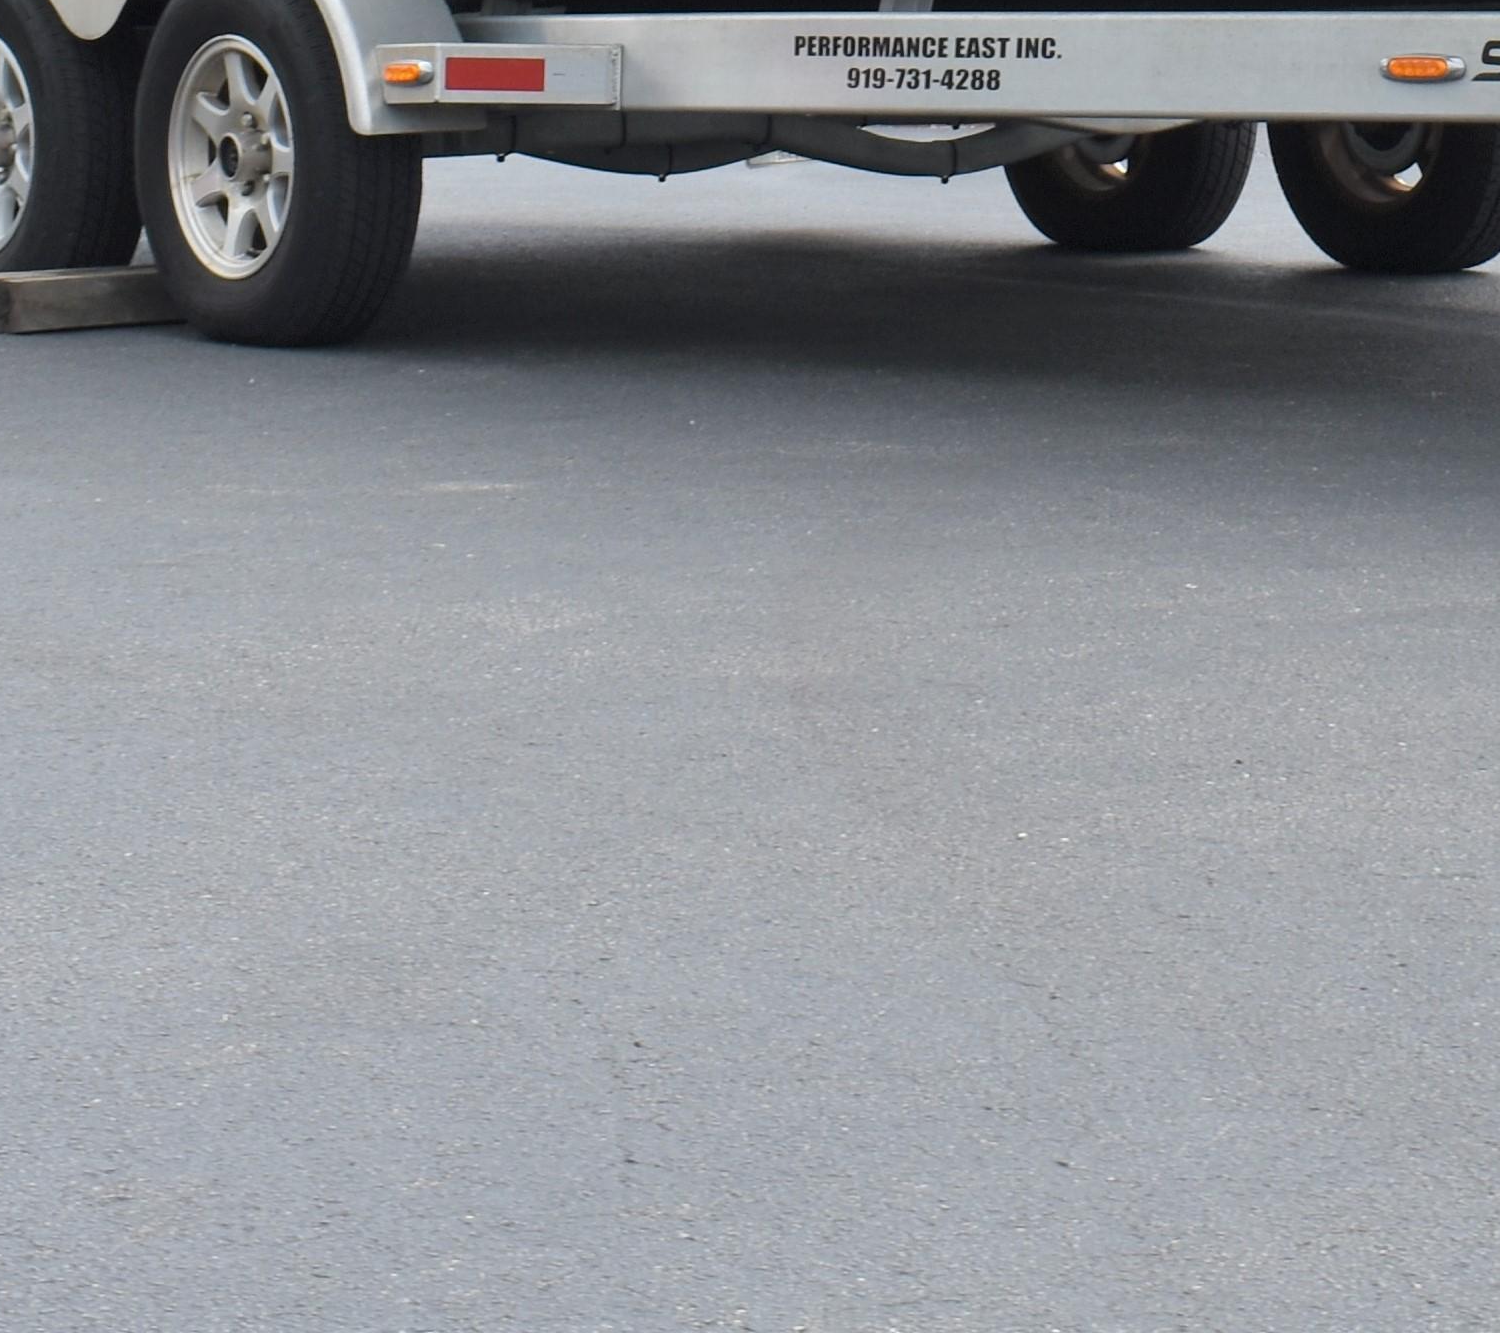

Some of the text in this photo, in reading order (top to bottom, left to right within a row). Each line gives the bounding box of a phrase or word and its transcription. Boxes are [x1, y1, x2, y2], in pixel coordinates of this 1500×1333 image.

[794, 36, 1063, 60] PERFORMANCE EAST INC.
[846, 67, 1001, 91] 919-731-4288
